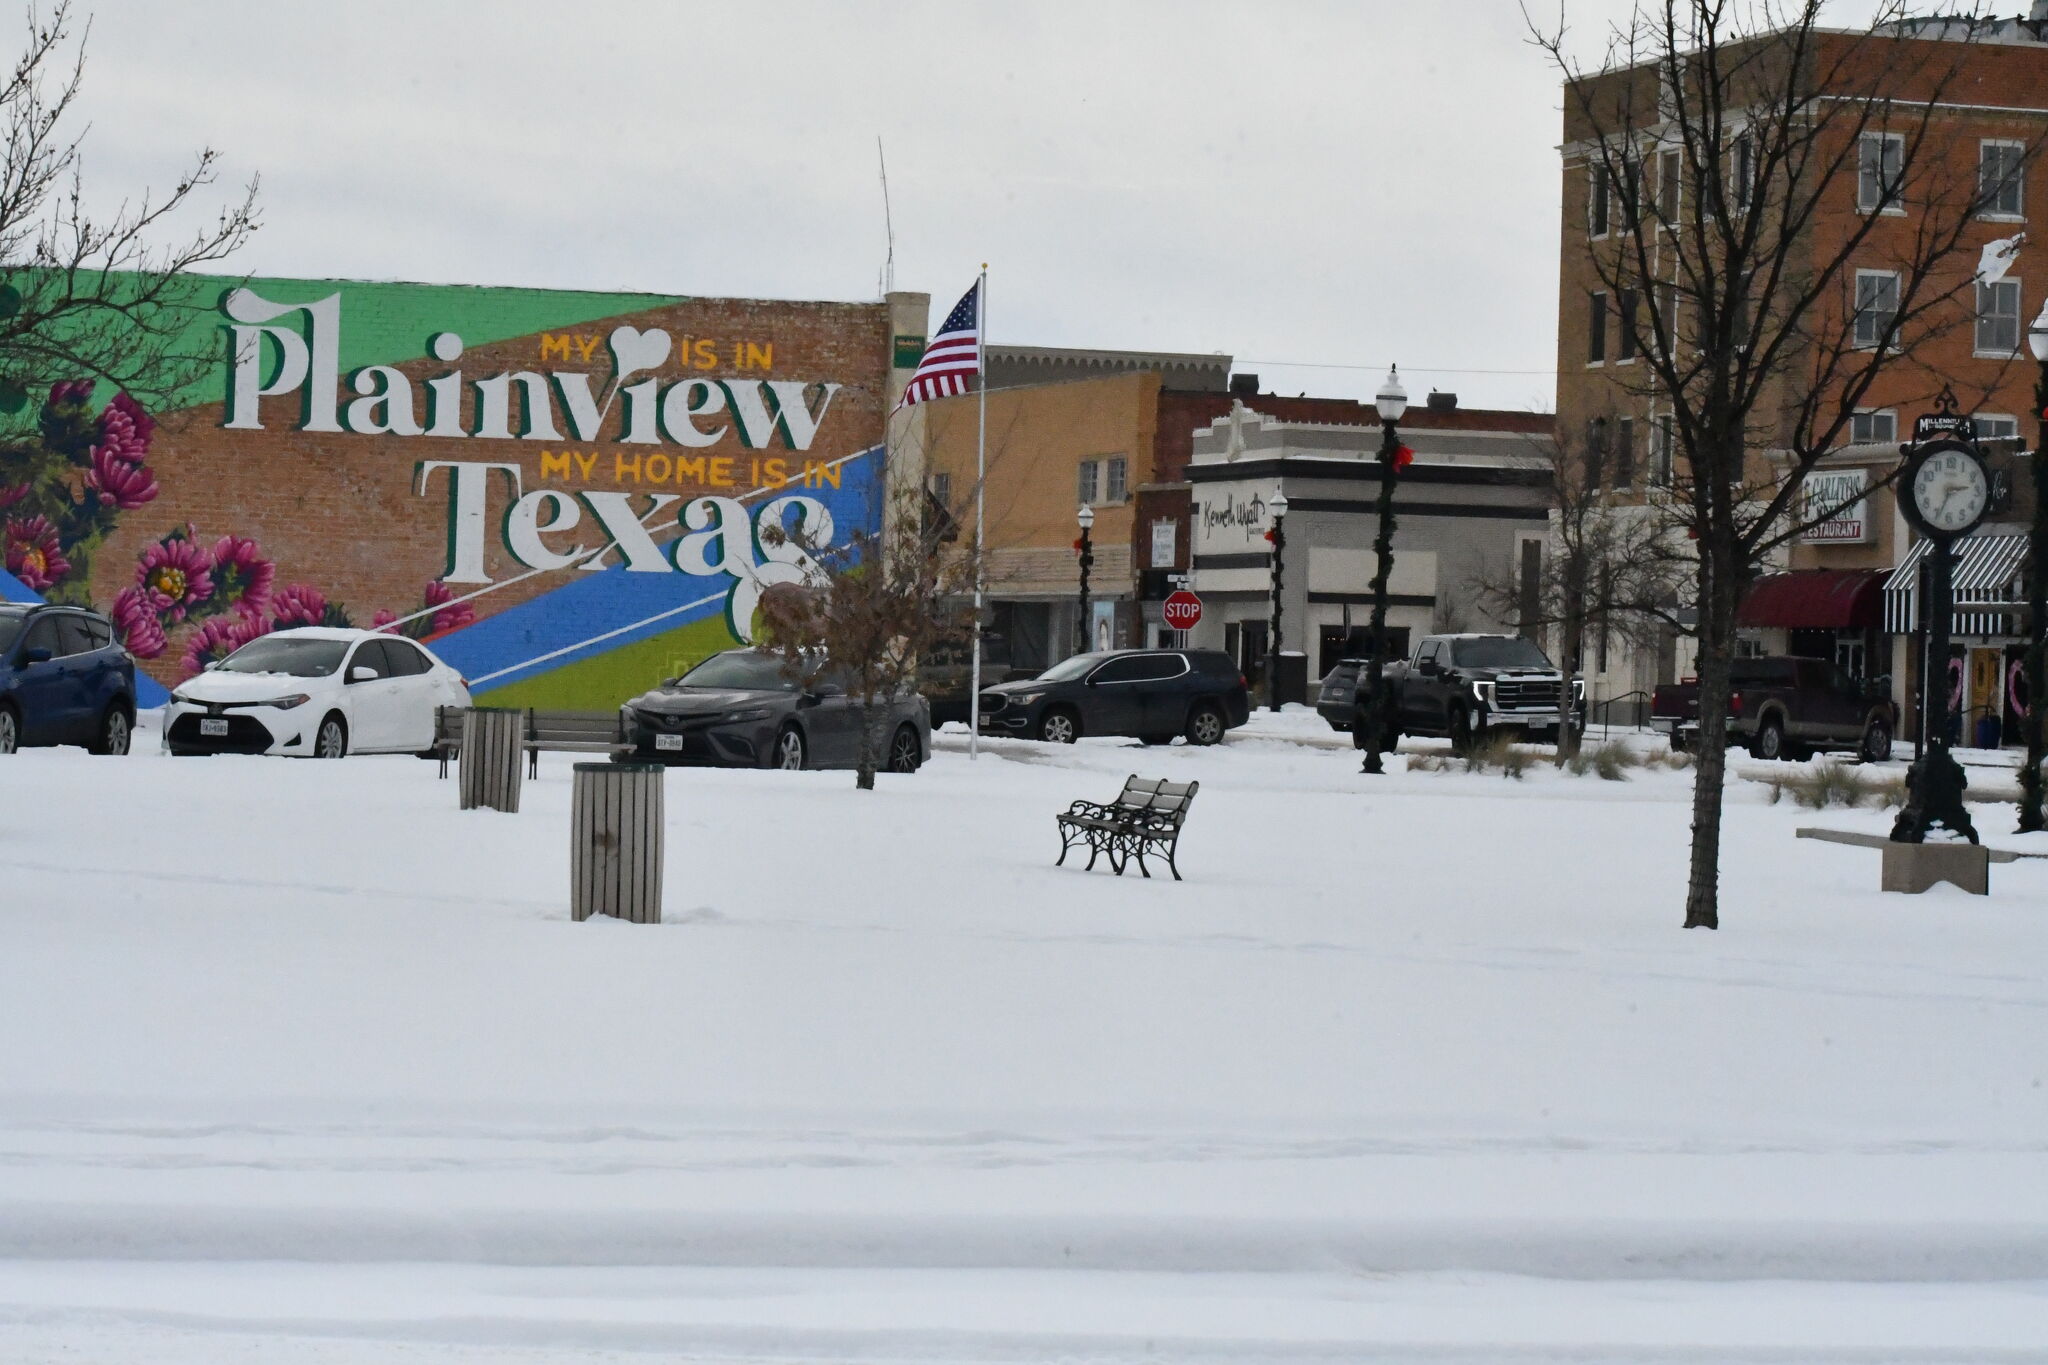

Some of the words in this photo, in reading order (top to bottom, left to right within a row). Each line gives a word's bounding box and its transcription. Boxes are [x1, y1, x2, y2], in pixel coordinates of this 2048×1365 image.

[221, 286, 843, 451] Plainview
[541, 333, 601, 361] MY
[681, 339, 718, 370] IS
[736, 342, 774, 371] IN
[541, 451, 599, 482] MY
[615, 454, 735, 486] HOME
[752, 458, 787, 490] IS
[805, 462, 842, 490] IN
[418, 460, 835, 645] Texas
[1166, 602, 1200, 618] STOP
